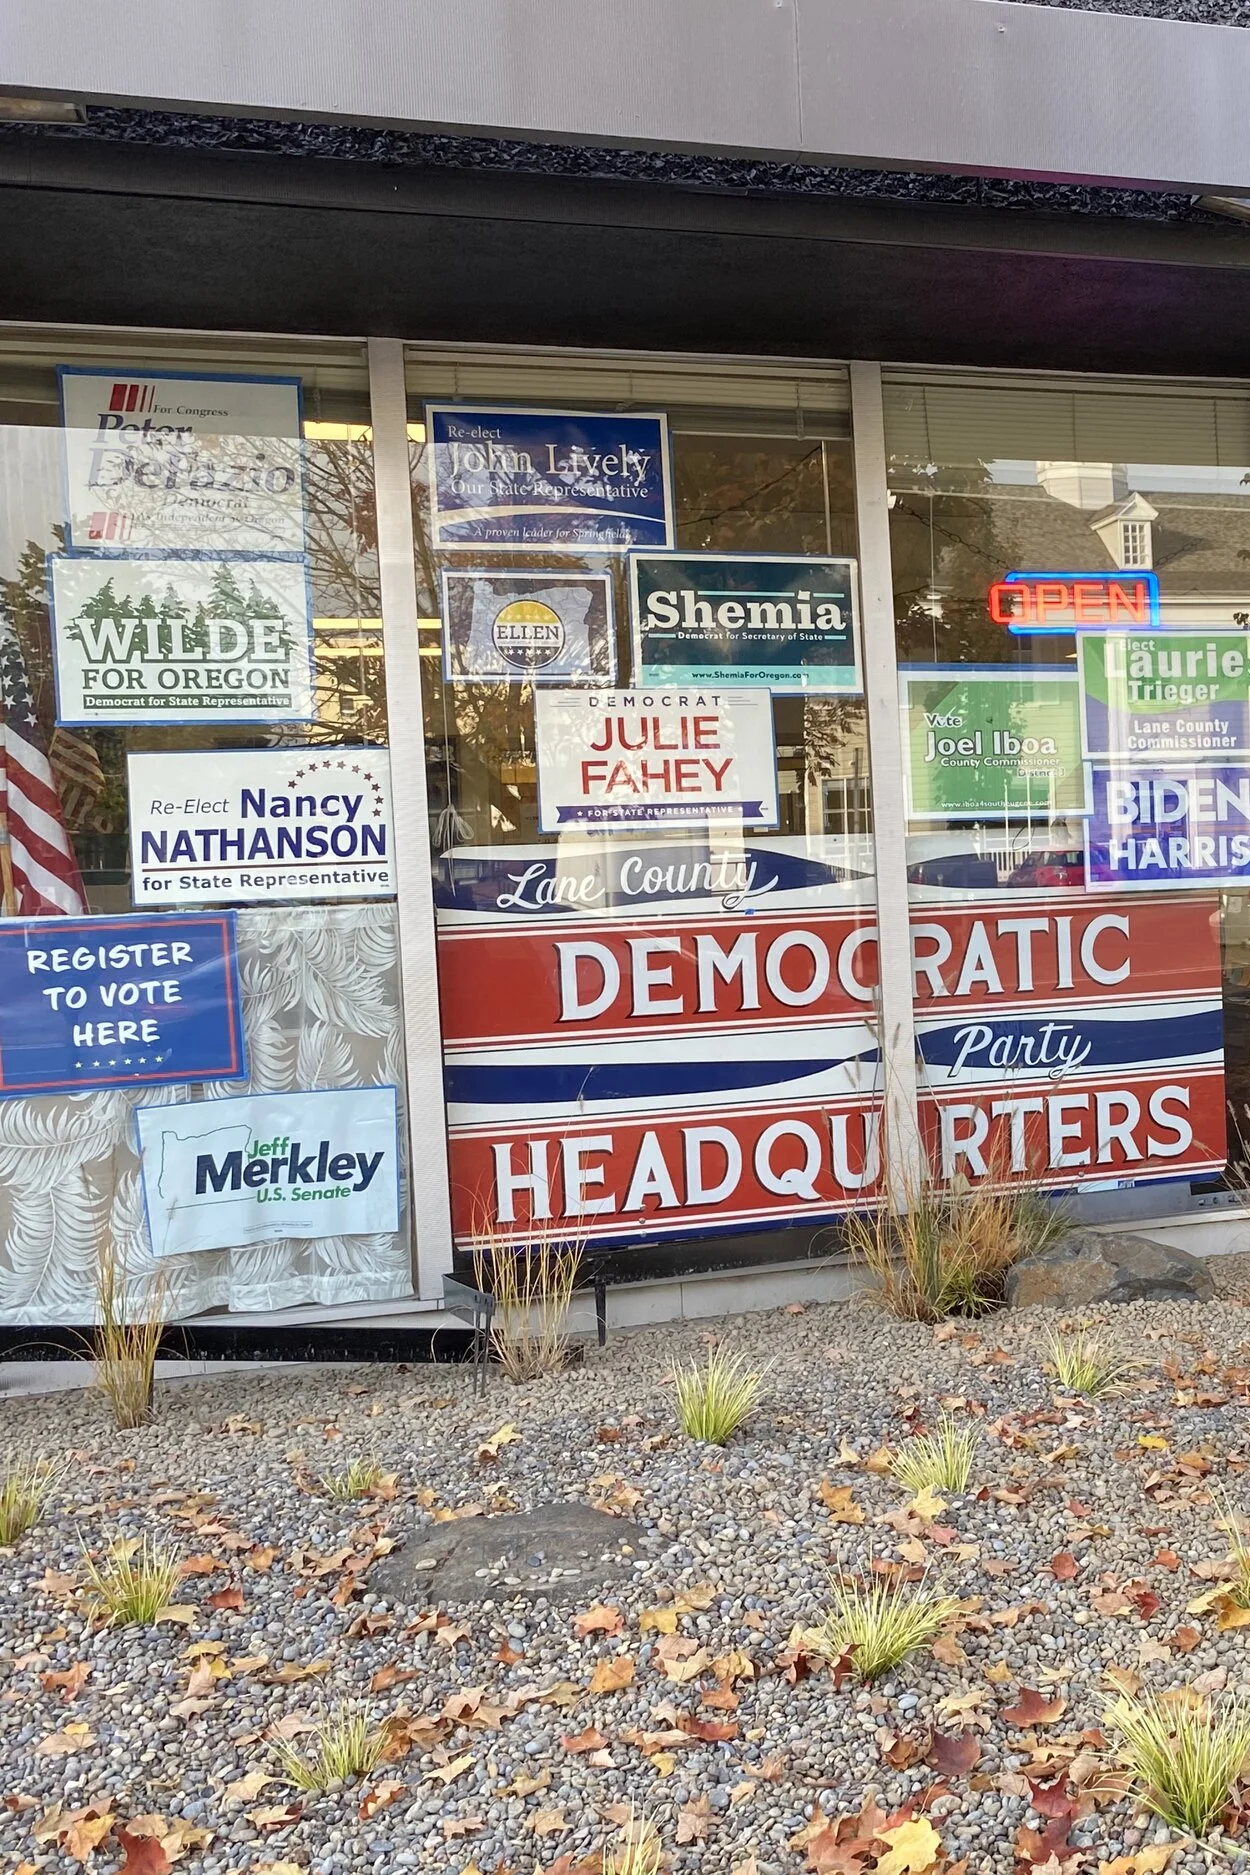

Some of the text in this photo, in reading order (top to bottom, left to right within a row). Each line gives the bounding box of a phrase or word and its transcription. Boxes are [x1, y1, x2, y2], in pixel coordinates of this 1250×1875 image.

[153, 405, 230, 417] For Congress
[92, 413, 193, 445] Peter
[448, 425, 502, 439] Re-elect
[450, 440, 651, 486] John Lively
[451, 480, 485, 495] Our
[532, 481, 649, 500] Representative
[485, 528, 520, 540] proven
[555, 527, 570, 539] for
[646, 590, 847, 630] Shemia
[988, 582, 1147, 624] OPEN
[75, 618, 290, 663] WILDE
[496, 625, 560, 640] ELLEN
[678, 631, 823, 642] Democrat for Secretary of State
[1104, 643, 1244, 679] Laurie
[82, 669, 290, 690] FOR OREGON
[692, 671, 809, 681] www.ShemiaForOregon.com
[86, 697, 290, 708] Democrat for State Representative
[589, 695, 721, 707] DEMOCRAT
[1128, 680, 1219, 705] Trieger
[924, 713, 962, 727] Vote
[1134, 719, 1229, 734] Lane County
[590, 716, 721, 752] JULIE
[924, 730, 1058, 762] Joel Iboa
[1127, 736, 1237, 749] Commissioner
[941, 757, 1061, 769] County Commissioner
[1018, 768, 1056, 777] Dstric
[581, 758, 734, 795] FAHEY
[150, 788, 364, 823] Re-Elect Nancy
[588, 806, 734, 817] FOR STATE REPRESENTATIVE
[1106, 778, 1250, 824] BIDEN
[141, 824, 386, 864] NATHANSON
[143, 869, 389, 891] for State Representative
[497, 850, 779, 910] Lane County
[27, 942, 193, 974] REGISTER
[42, 980, 182, 1011] TO VOTE
[72, 1019, 161, 1047] HERE
[948, 1023, 1092, 1079] Party
[247, 1136, 290, 1159] Jeff
[496, 1085, 1194, 1223] HEADQURTERS
[195, 1141, 385, 1195] Merkley
[256, 1186, 351, 1203] U.S. Senate
